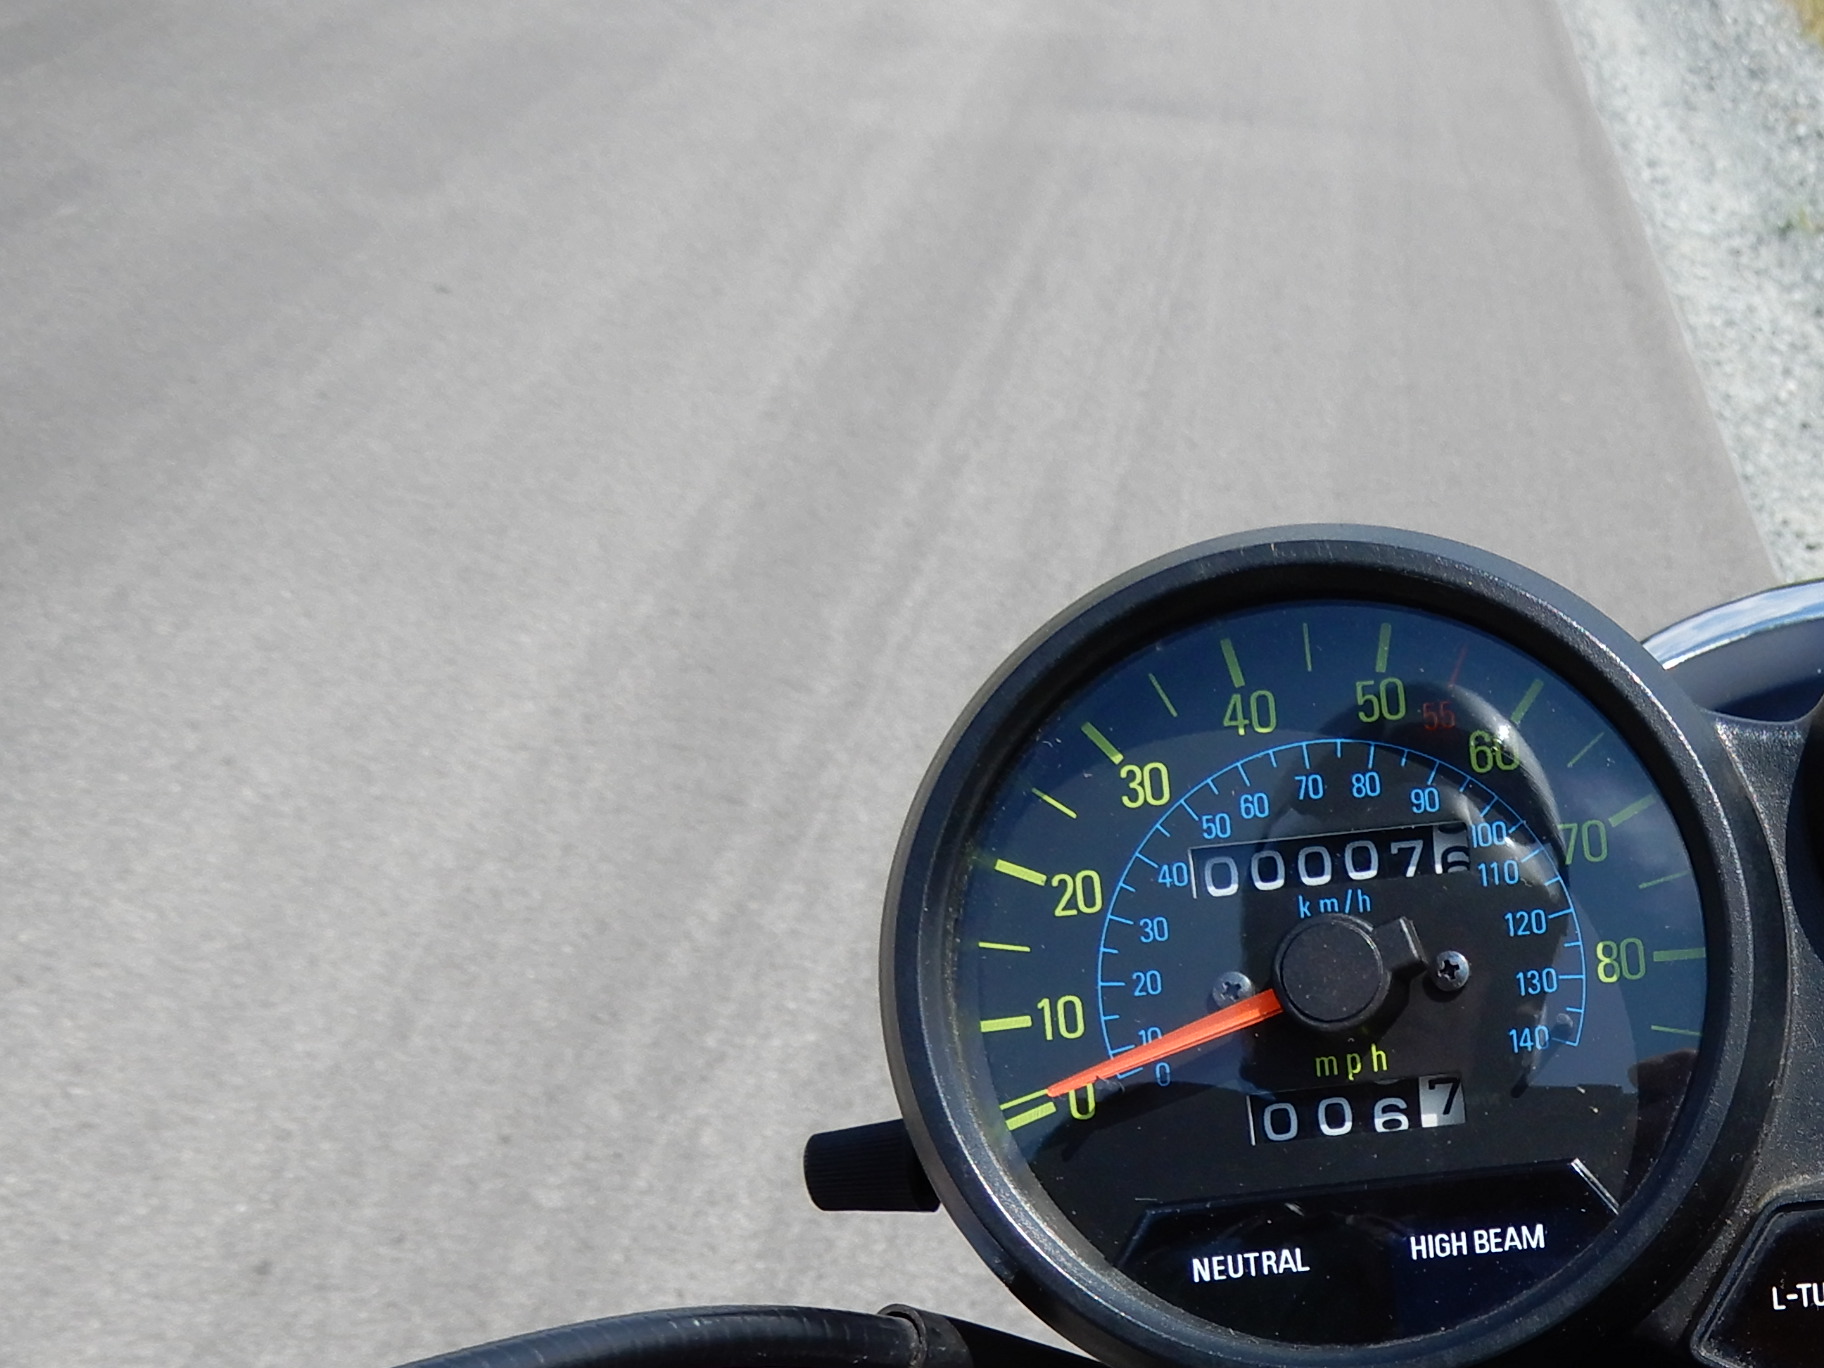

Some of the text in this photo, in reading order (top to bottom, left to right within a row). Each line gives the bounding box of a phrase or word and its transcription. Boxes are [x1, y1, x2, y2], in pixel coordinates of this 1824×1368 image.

[1222, 689, 1276, 735] 40
[1355, 677, 1406, 724] 50
[1422, 702, 1456, 731] 55
[1469, 729, 1521, 774] 60
[1119, 761, 1171, 809] 30
[1295, 775, 1323, 801] 70
[1351, 772, 1380, 798] 80
[1240, 792, 1270, 819] 60
[1410, 787, 1440, 813] 90
[1202, 813, 1232, 840] 50
[1472, 821, 1507, 848] 100
[1561, 819, 1608, 865] 70
[1158, 862, 1188, 888] 40
[1477, 859, 1519, 887] 110
[1051, 870, 1102, 918] 20
[1139, 916, 1169, 944] 30
[1504, 908, 1547, 937] 120
[1596, 937, 1647, 986] 80
[1133, 971, 1162, 997] 20
[1516, 967, 1558, 996] 130
[1036, 994, 1084, 1041] 10
[1509, 1026, 1549, 1054] 140
[1155, 1062, 1171, 1087] 0
[1315, 1043, 1388, 1081] mph
[1410, 1224, 1545, 1261] HIGH BEAM
[1192, 1248, 1310, 1284] NEUTRAL
